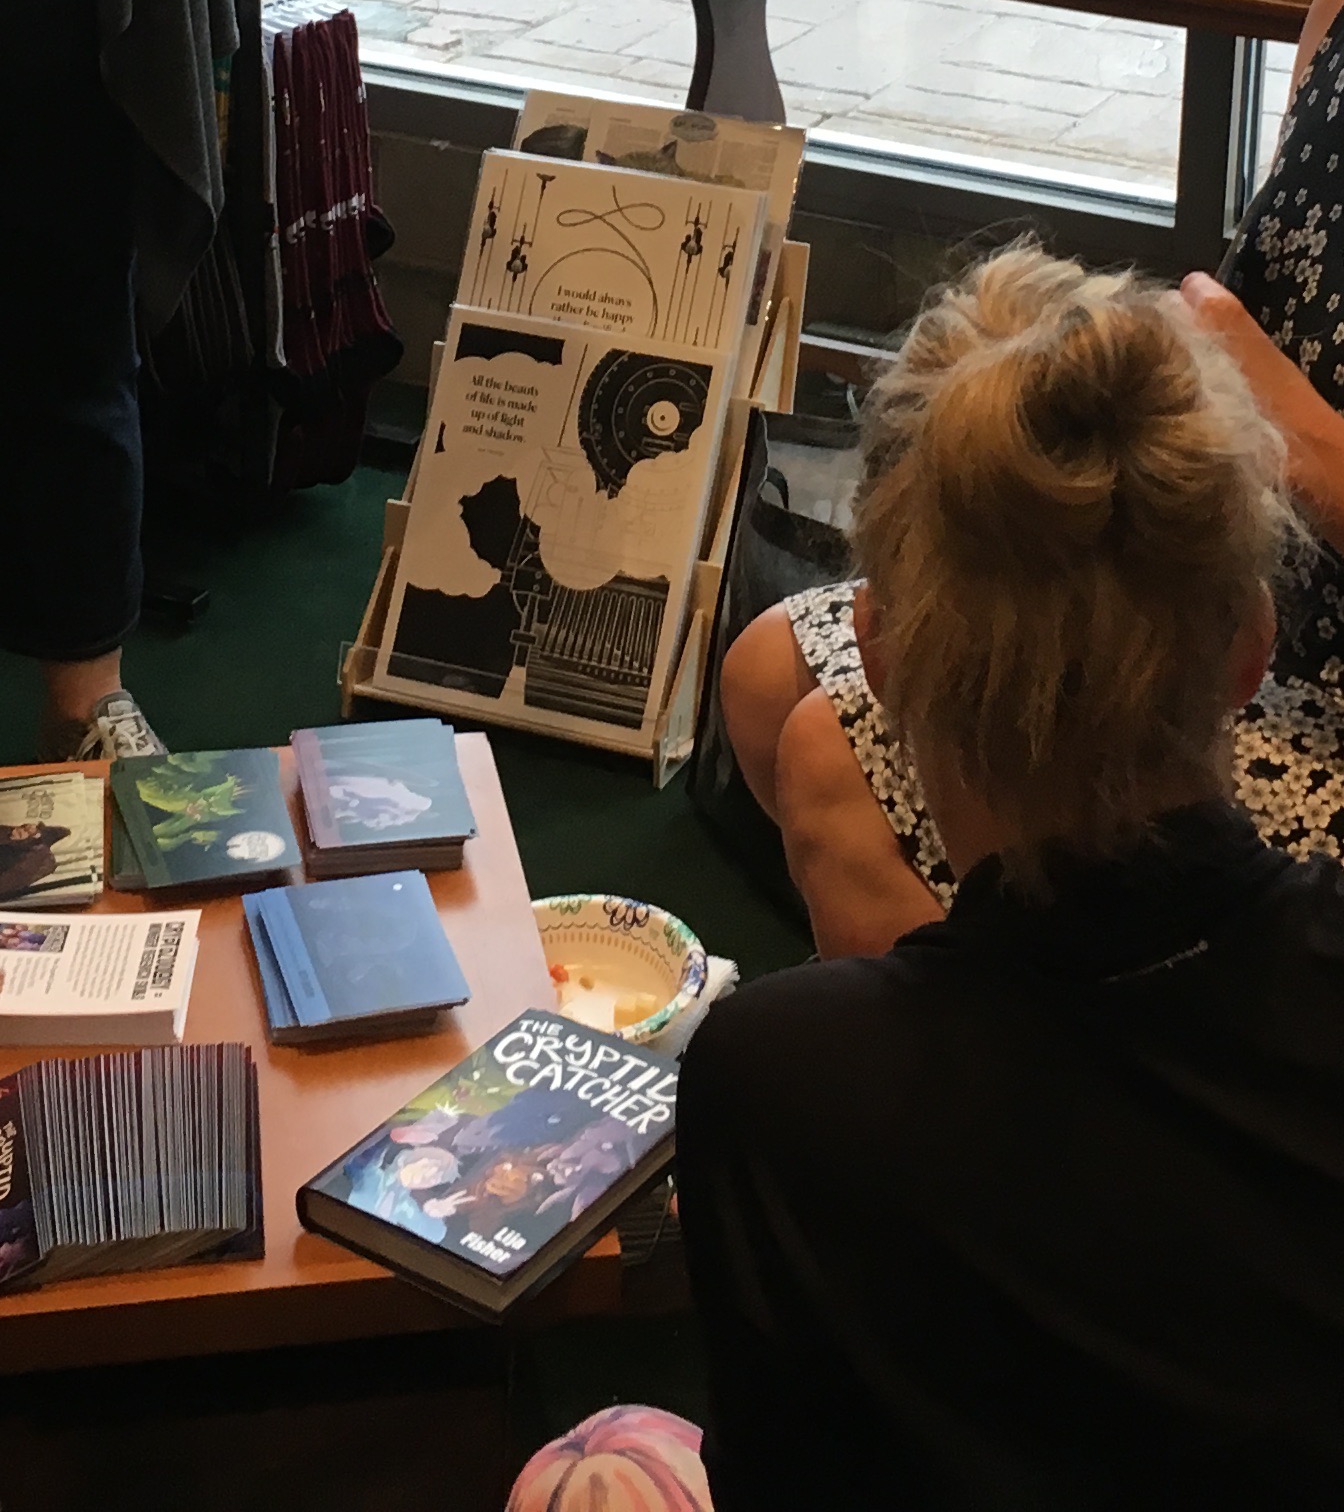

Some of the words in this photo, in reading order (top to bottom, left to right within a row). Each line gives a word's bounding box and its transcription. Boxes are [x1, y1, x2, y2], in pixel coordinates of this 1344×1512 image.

[557, 285, 562, 297] I
[563, 288, 597, 302] would
[550, 301, 584, 316] rather
[585, 304, 599, 318] be
[601, 307, 634, 326] happy
[472, 374, 485, 387] All
[485, 376, 502, 390] the
[504, 380, 539, 398] beauty
[465, 390, 479, 402] of
[479, 391, 494, 406] life
[497, 395, 506, 407] is
[507, 400, 537, 414] made
[471, 409, 486, 422] up
[486, 411, 500, 423] of
[501, 412, 525, 428] light
[462, 424, 484, 436] and
[518, 1019, 563, 1036] THE
[506, 1060, 671, 1135] CATCHER
